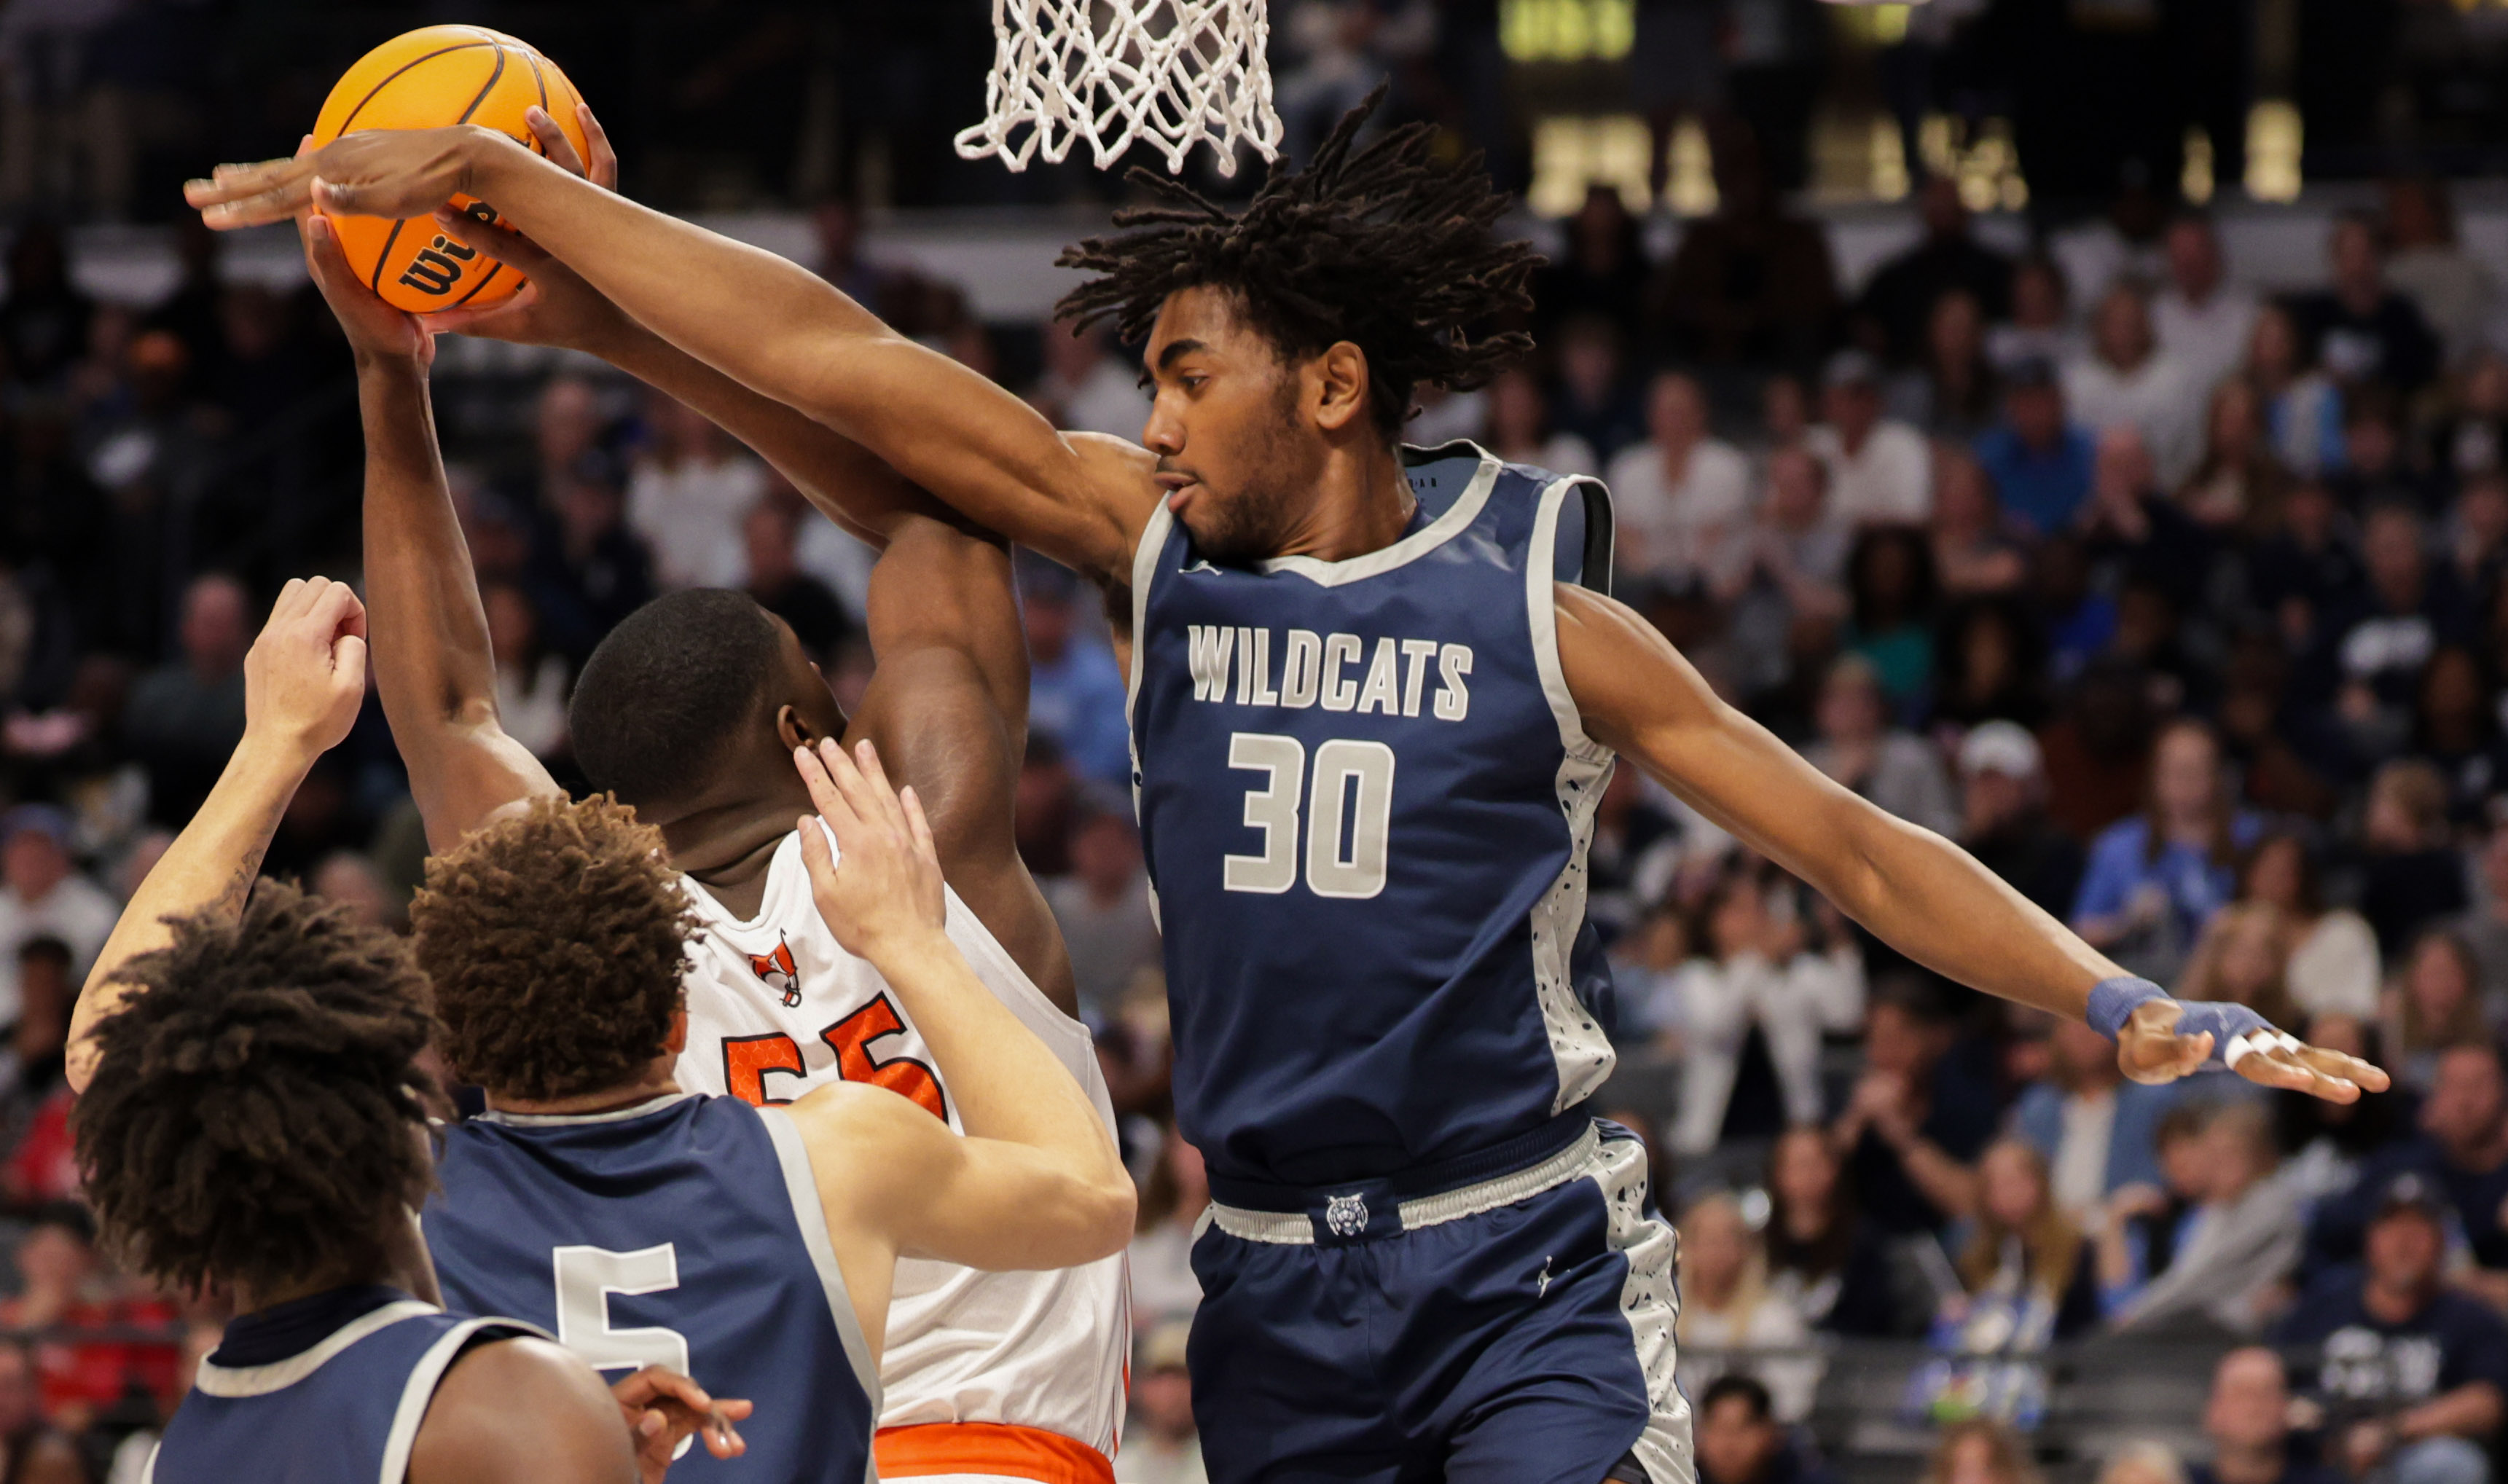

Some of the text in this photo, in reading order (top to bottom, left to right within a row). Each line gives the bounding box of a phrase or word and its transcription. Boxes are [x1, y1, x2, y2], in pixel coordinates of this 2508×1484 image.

[1188, 624, 1473, 721] WILDCATS
[1223, 731, 1395, 899] 30
[552, 1241, 694, 1461] 5
